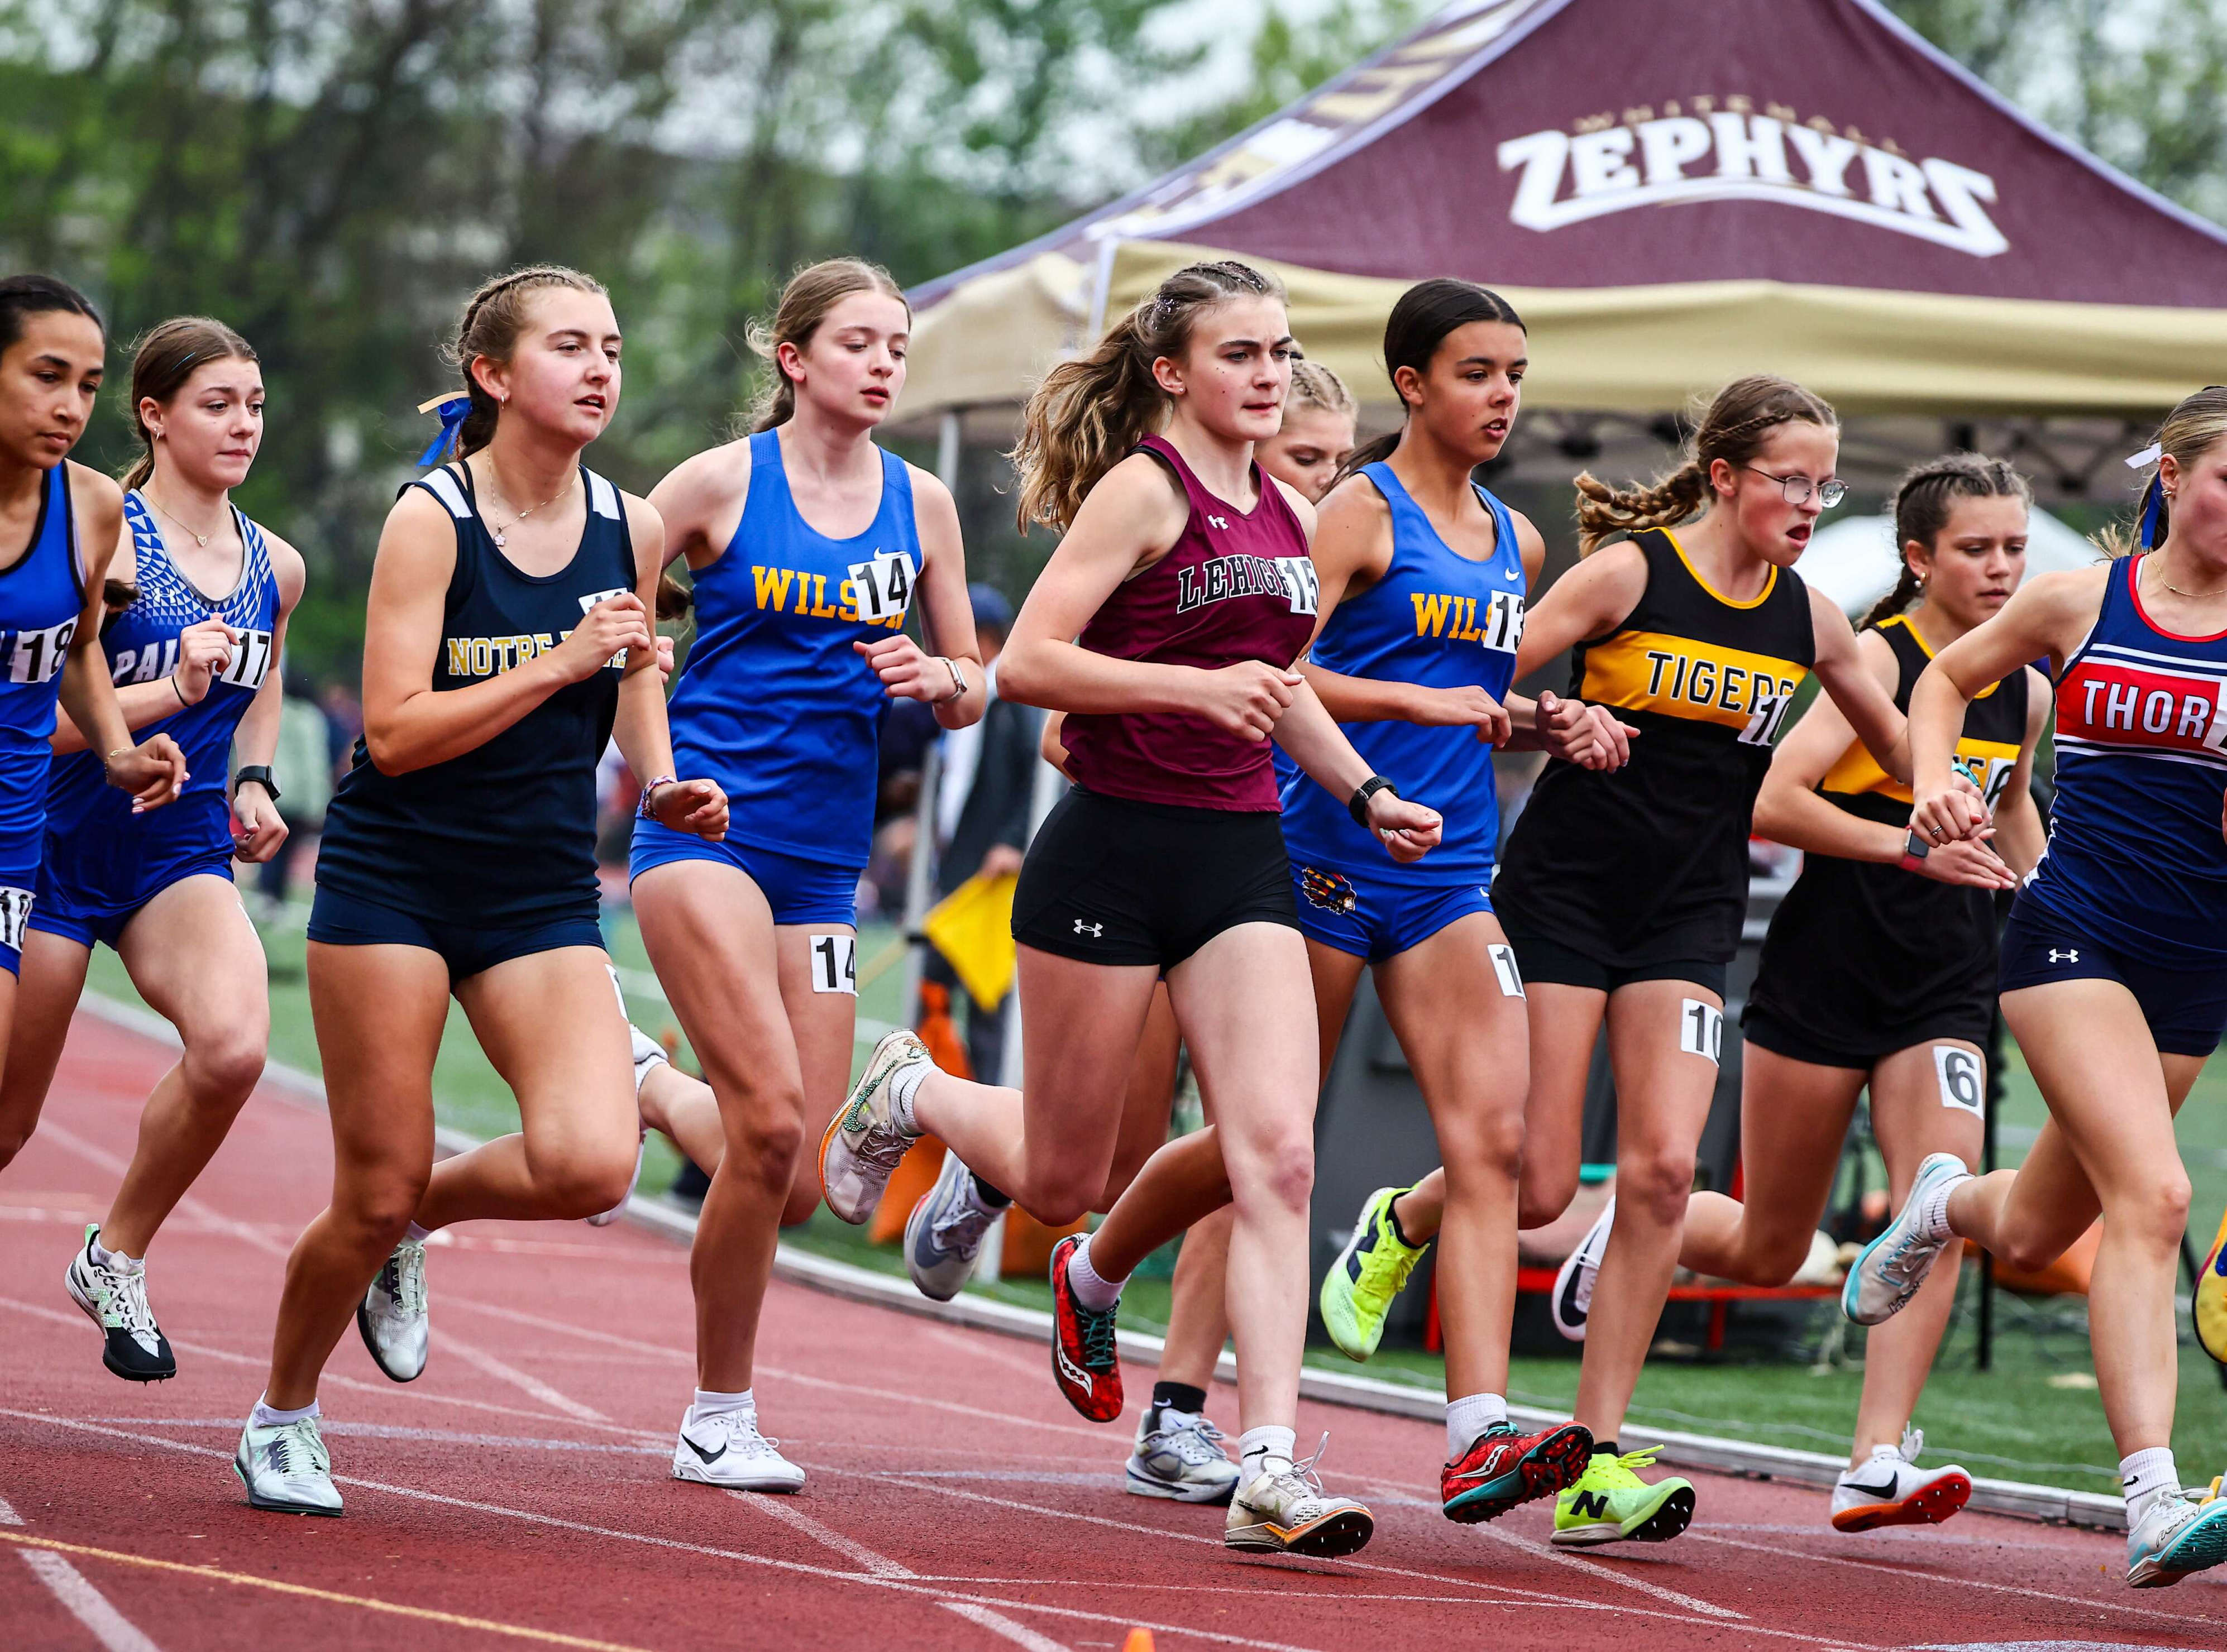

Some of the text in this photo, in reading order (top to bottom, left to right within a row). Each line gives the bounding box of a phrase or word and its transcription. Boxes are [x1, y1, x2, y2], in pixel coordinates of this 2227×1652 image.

[1498, 112, 2009, 257] ZEPHYRS
[752, 566, 905, 629] WILS
[856, 558, 908, 615] 14
[1284, 560, 1318, 613] 15
[22, 623, 74, 681] 18
[113, 638, 180, 684] PAL
[233, 631, 270, 685] 17
[447, 633, 554, 676] NOTRE
[2083, 680, 2210, 738] THOR
[0, 890, 31, 950] 18
[816, 937, 856, 990] 14
[1689, 1005, 1723, 1065] 10
[1946, 1052, 1979, 1107] 6
[1569, 1490, 1609, 1519] N
